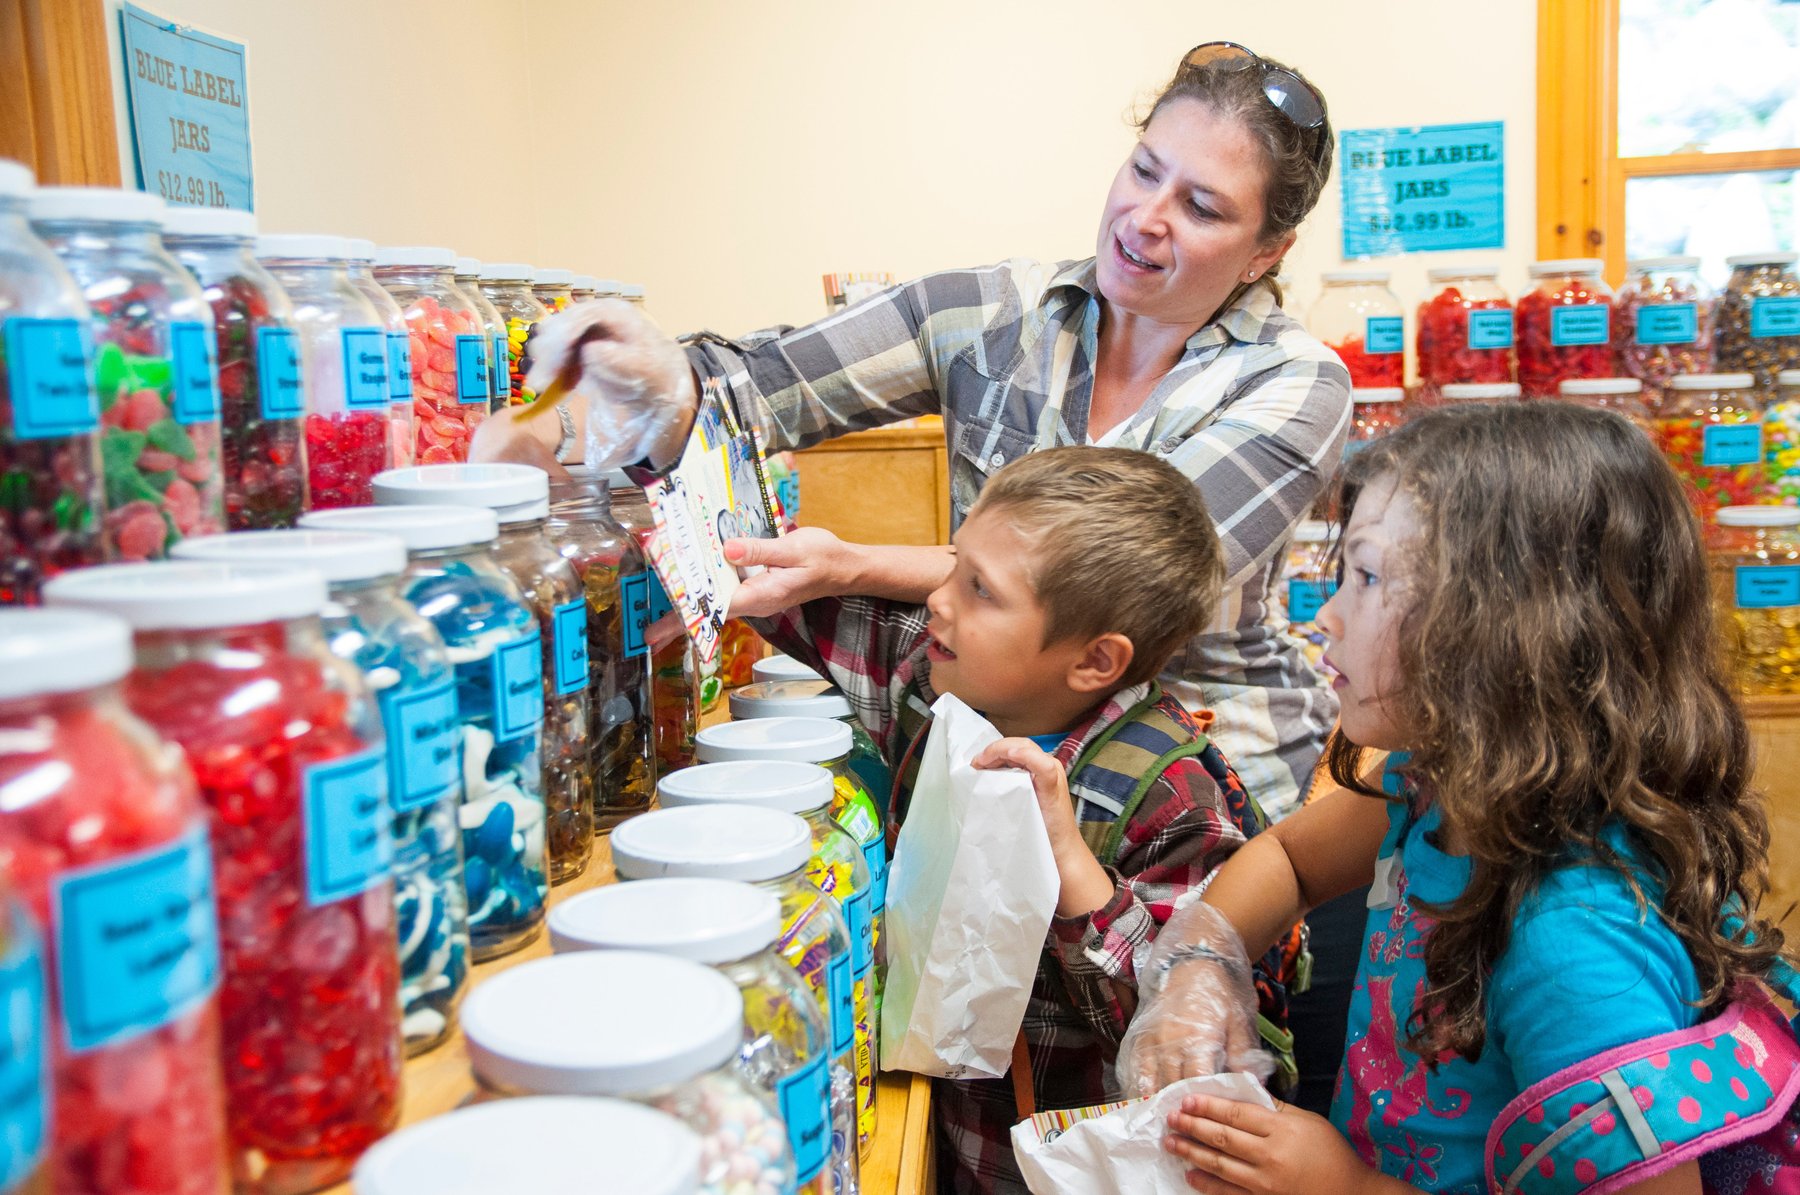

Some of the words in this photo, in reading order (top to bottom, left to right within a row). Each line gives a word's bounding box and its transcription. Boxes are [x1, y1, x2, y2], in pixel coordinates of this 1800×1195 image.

[135, 47, 177, 90] BLUE
[180, 65, 241, 108] LABEL
[169, 117, 210, 153] JARS
[1416, 143, 1498, 166] LABEL
[158, 169, 205, 206] $12.99
[208, 181, 230, 209] lb.
[1394, 180, 1450, 204] JARS
[1444, 210, 1475, 229] lb.
[698, 493, 723, 569] CANDY
